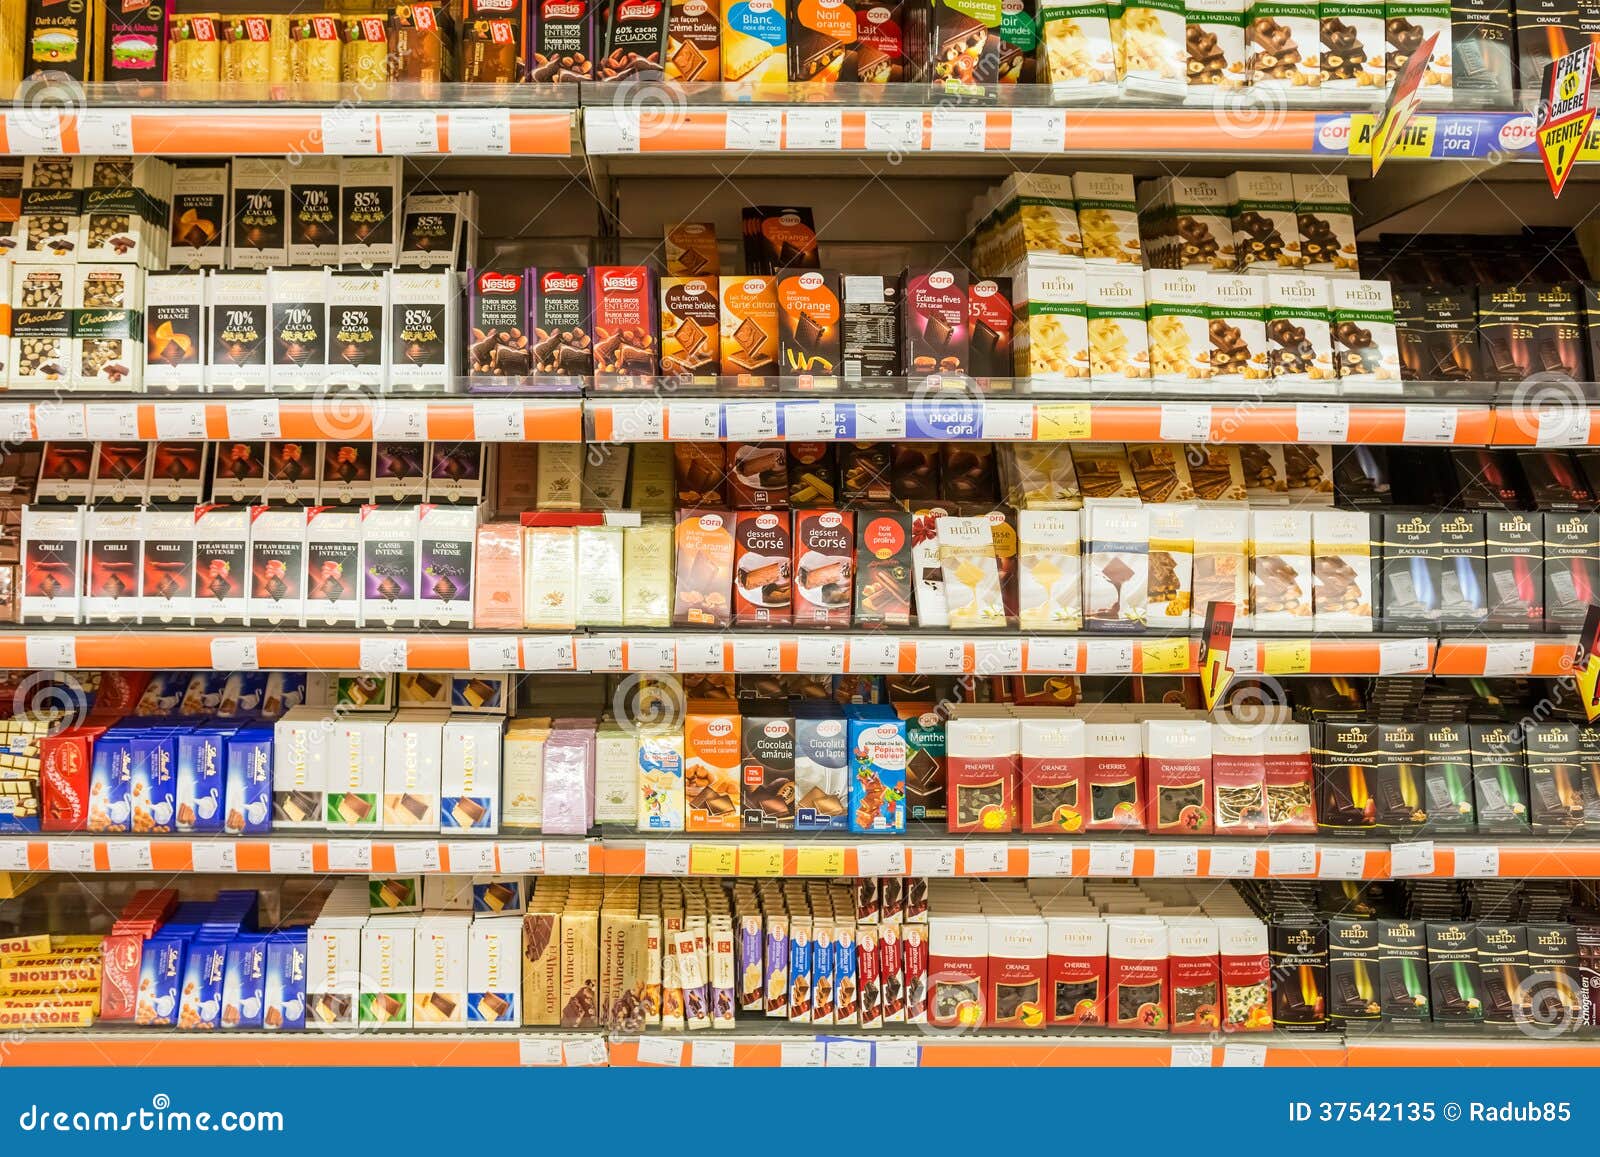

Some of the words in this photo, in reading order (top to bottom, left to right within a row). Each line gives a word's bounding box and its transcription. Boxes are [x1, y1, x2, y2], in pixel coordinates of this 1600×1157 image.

[816, 10, 840, 19] Noir
[1046, 10, 1066, 18] WHITE
[1072, 8, 1106, 16] HAZELNUTS
[35, 16, 50, 25] Dark
[58, 16, 76, 26] Coffee
[681, 17, 698, 25] façon
[743, 15, 772, 24] Blanc
[816, 21, 851, 30] orange
[858, 25, 876, 34] Lait
[615, 33, 657, 42] ECUADOR
[1552, 93, 1584, 117] CADERE
[247, 195, 272, 209] 70%
[303, 191, 328, 204] 70%
[354, 192, 379, 206] 85%
[418, 217, 443, 226] 85%
[1042, 282, 1074, 290] HEIDI
[1100, 288, 1132, 296] HEIDI
[1217, 287, 1252, 296] HEIDI
[1281, 287, 1315, 296] HEIDI
[1346, 291, 1381, 300] HEIDI
[943, 295, 960, 303] fèves
[1491, 293, 1526, 302] HEIDI
[1538, 293, 1571, 302] HEIDI
[787, 301, 831, 312] d'Orange
[227, 311, 254, 326] 70%
[285, 309, 311, 324] 70%
[342, 311, 368, 326] 85%
[405, 310, 431, 324] 85%
[929, 412, 973, 423] produs
[946, 424, 973, 435] cora
[1397, 524, 1430, 534] HEIDI
[1441, 523, 1473, 533] HEIDI
[1499, 523, 1531, 532] HEIDI
[1557, 524, 1588, 533] HEIDI
[747, 530, 775, 538] dessert
[810, 528, 838, 537] dessert
[747, 537, 784, 549] Corsé
[809, 536, 846, 548] Corsé
[709, 724, 731, 732] cora
[910, 733, 944, 742] Menthe
[1337, 733, 1367, 742] HEIDI
[1384, 733, 1413, 741] HEIDI
[1429, 733, 1458, 741] HEIDI
[1481, 734, 1510, 743] HEIDI
[1538, 734, 1568, 742] HEIDI
[757, 741, 793, 749] Ciocolată
[810, 740, 845, 748] Ciocolată
[762, 751, 792, 759] amăruie
[826, 749, 845, 759] lapte
[1340, 930, 1368, 938] HEIDI
[1388, 928, 1416, 937] HEIDI
[1437, 932, 1466, 940] HEIDI
[1288, 936, 1316, 944] HEIDI
[1487, 935, 1516, 943] HEIDI
[1538, 937, 1567, 945] HEIDI
[10, 968, 96, 982] TOBLERONE
